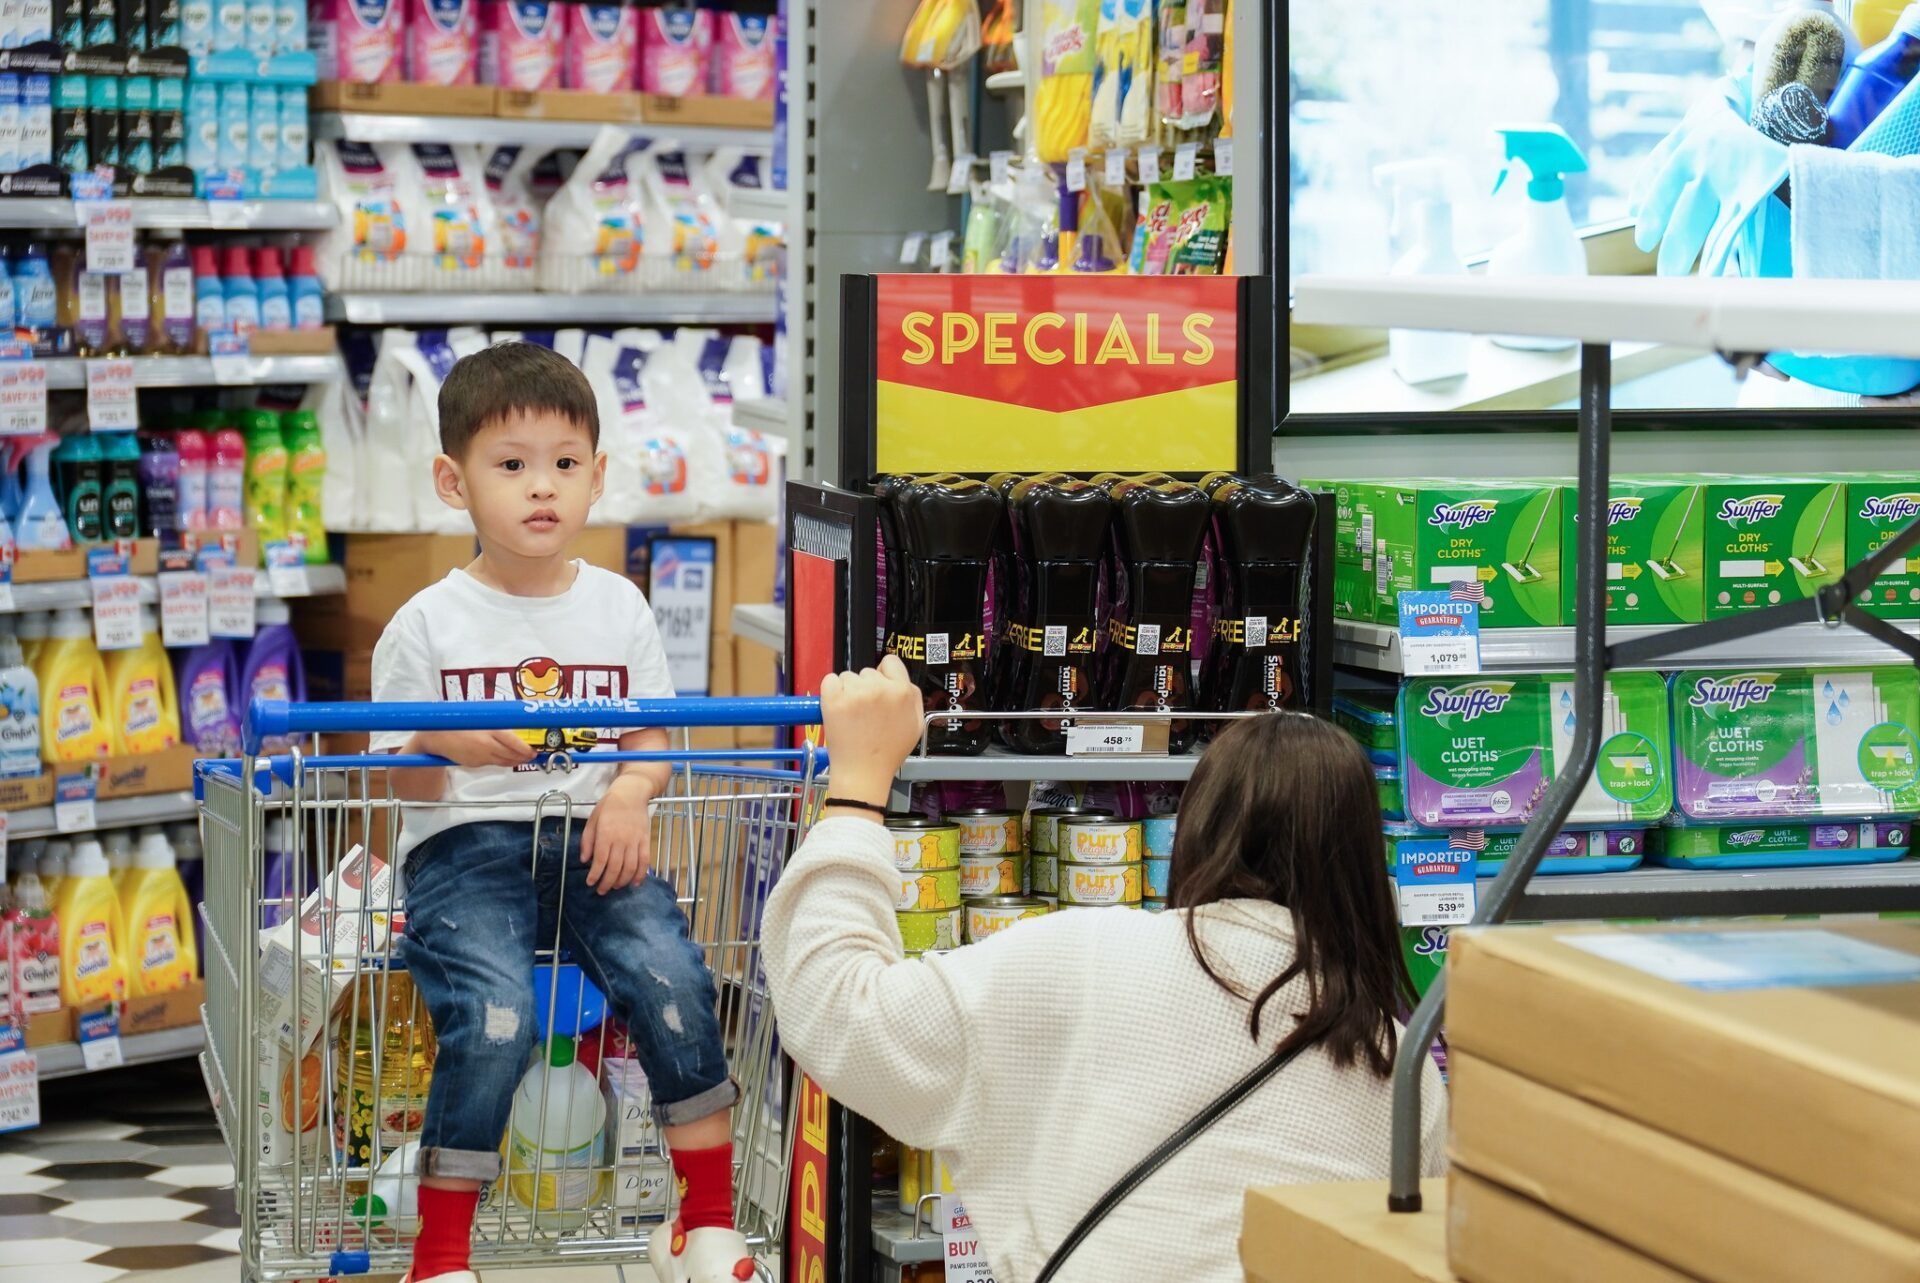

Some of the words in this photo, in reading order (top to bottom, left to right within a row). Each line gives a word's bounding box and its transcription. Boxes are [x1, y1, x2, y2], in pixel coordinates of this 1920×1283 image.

[902, 311, 1214, 365] SPECIALS
[1429, 504, 1495, 529] Swiffer
[1717, 499, 1782, 524] Swiffer
[1450, 538, 1473, 548] DRY
[1738, 533, 1761, 542] DRY
[1437, 549, 1482, 559] CLOTHS
[1726, 543, 1769, 553] CLOTHS
[1402, 602, 1473, 616] IMPORTED
[1418, 616, 1459, 626] GUARANTEED
[897, 635, 925, 660] FREE
[1690, 677, 1776, 712] Swiffer
[1421, 688, 1511, 722] Swiffer
[1718, 727, 1752, 739] WET
[1452, 737, 1486, 749] WET
[1708, 740, 1765, 753] CLOTHS
[1441, 750, 1500, 763] CLOTHS
[1610, 780, 1626, 789] trap
[1634, 779, 1651, 787] lock
[1727, 831, 1763, 846] Swiffer
[1773, 829, 1791, 837] WET
[1077, 832, 1121, 848] Purr
[1768, 836, 1799, 844] CLOTHS
[1401, 851, 1472, 865] IMPORTED
[1417, 864, 1457, 875] GUARANTEED
[1075, 872, 1120, 889] Purr
[625, 1174, 665, 1190] Dove
[948, 1240, 978, 1257] BUY
